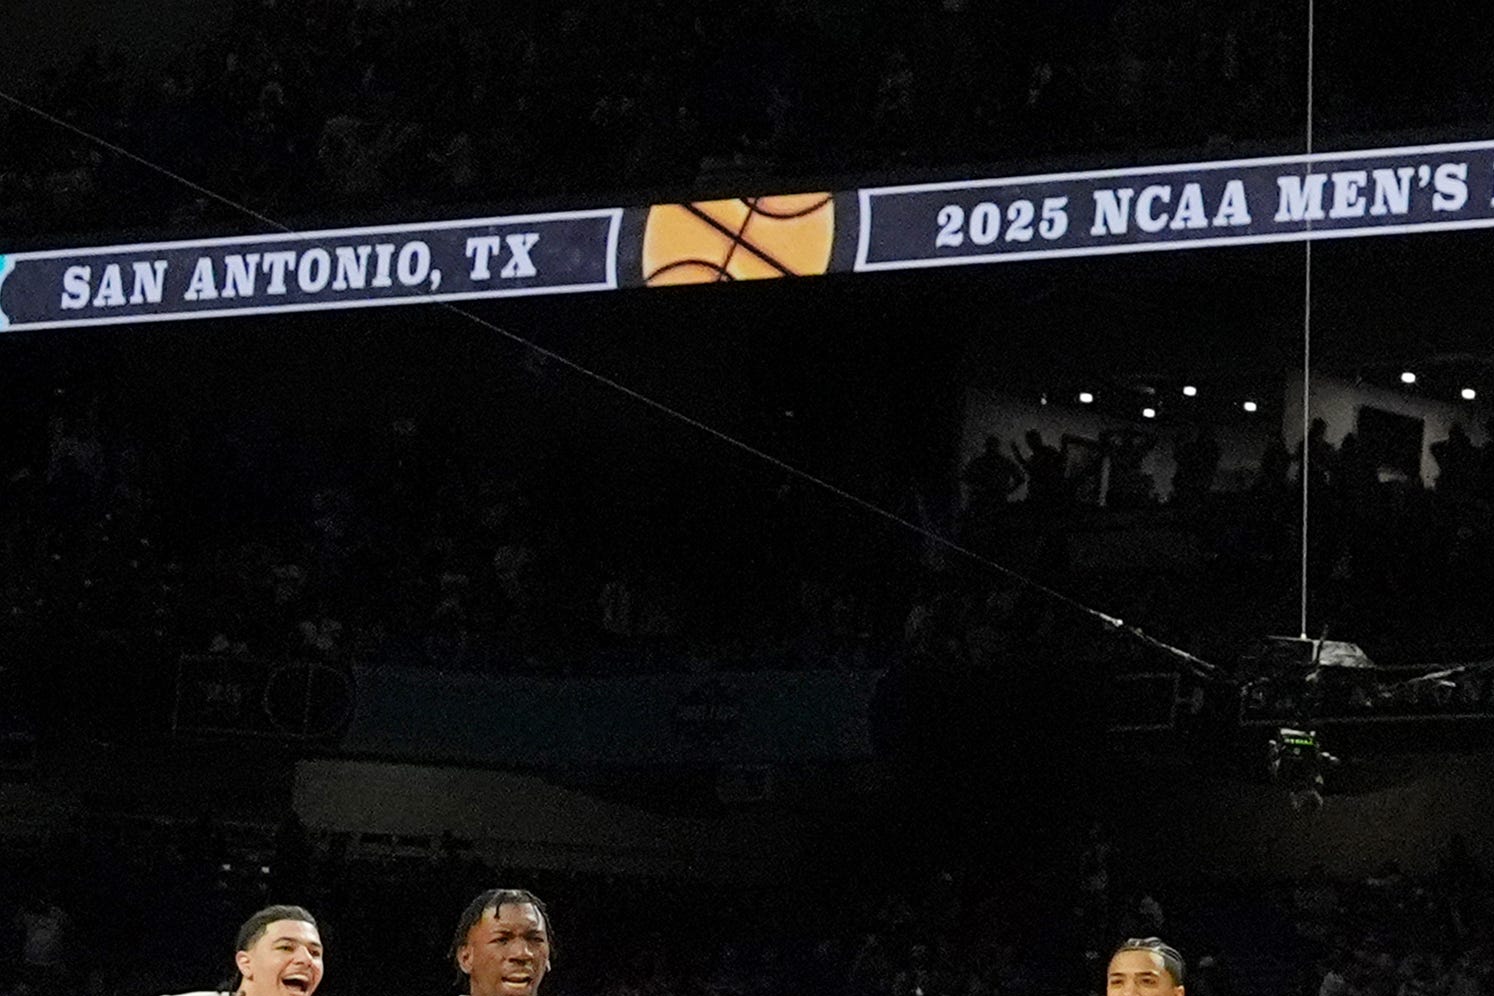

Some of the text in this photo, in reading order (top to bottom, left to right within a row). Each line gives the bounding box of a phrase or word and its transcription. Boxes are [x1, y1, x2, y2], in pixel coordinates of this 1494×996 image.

[935, 197, 1069, 249] 2025
[1090, 179, 1251, 236] NCAA
[61, 233, 540, 309] SAN ANTONIO, TX
